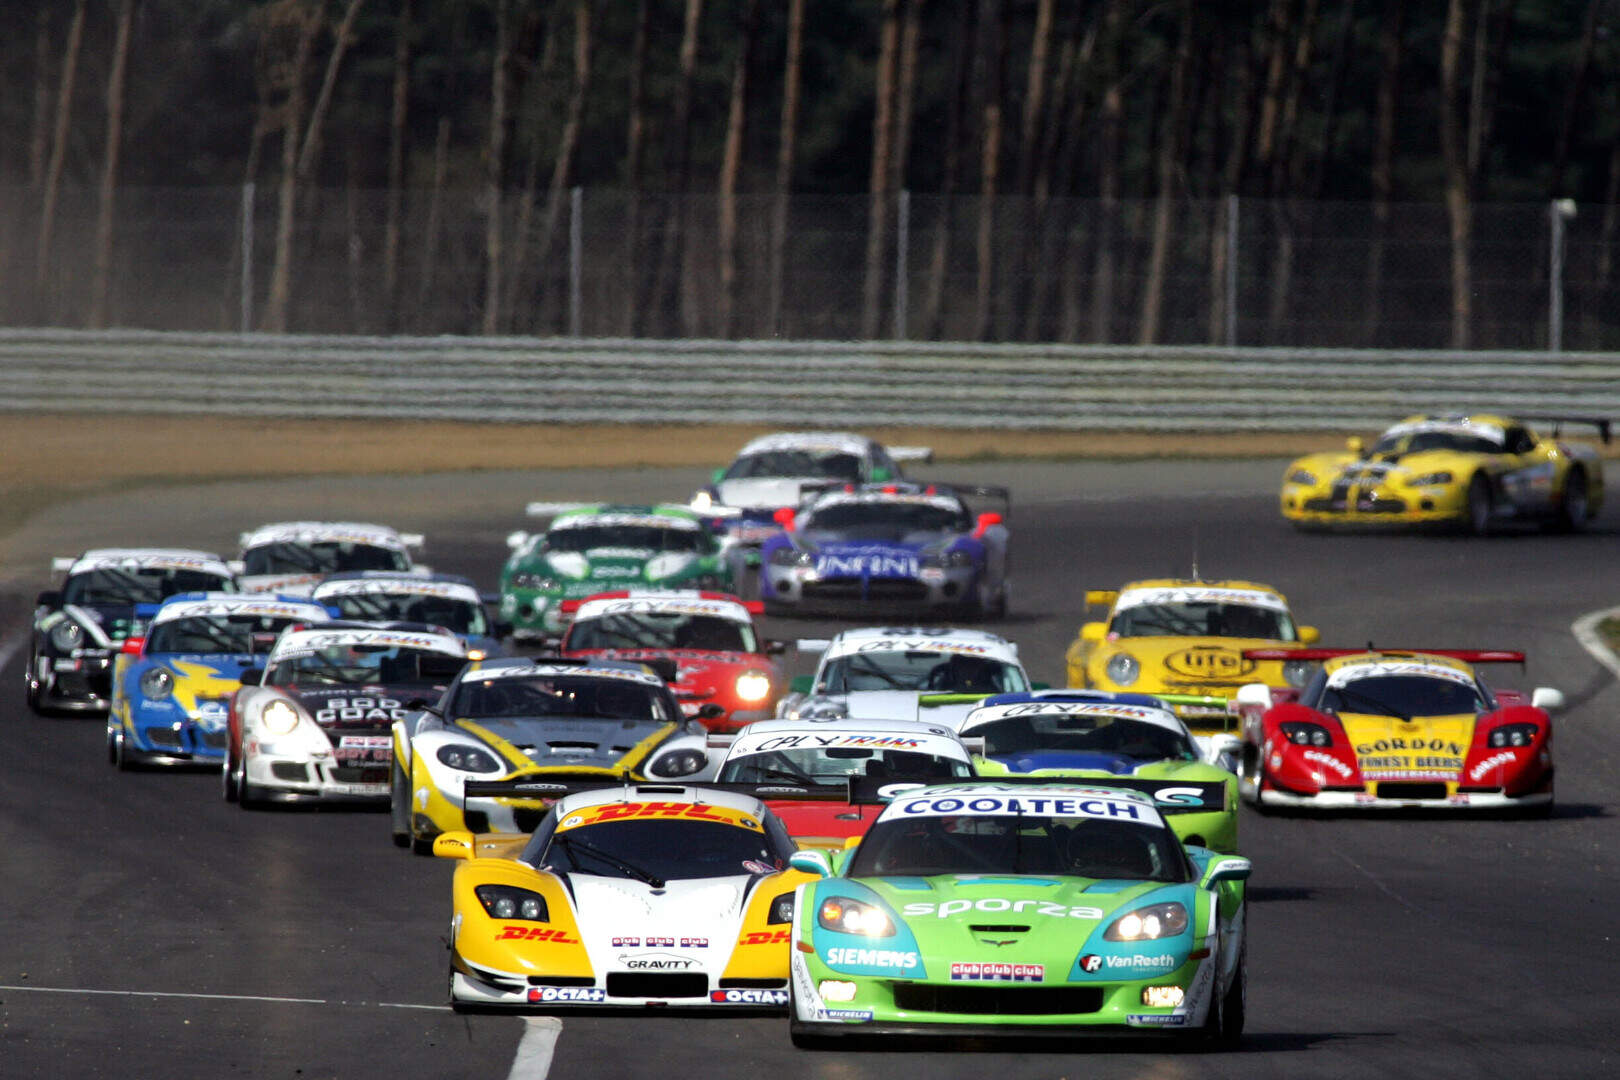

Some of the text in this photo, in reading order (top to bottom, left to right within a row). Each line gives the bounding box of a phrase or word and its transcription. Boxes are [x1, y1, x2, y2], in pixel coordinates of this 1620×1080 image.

[316, 708, 408, 723] COAC
[1357, 738, 1463, 755] GORDON
[584, 802, 734, 825] DHL
[903, 799, 1139, 820] COOLTECH
[902, 897, 1105, 919] sporza
[495, 925, 579, 944] DHL
[739, 931, 791, 945] DH
[627, 960, 693, 969] GRAVITY
[827, 948, 918, 968] SIEMENS
[952, 963, 1043, 976] club club club
[542, 988, 604, 1002] OCTA+
[726, 990, 788, 1004] OCTA+
